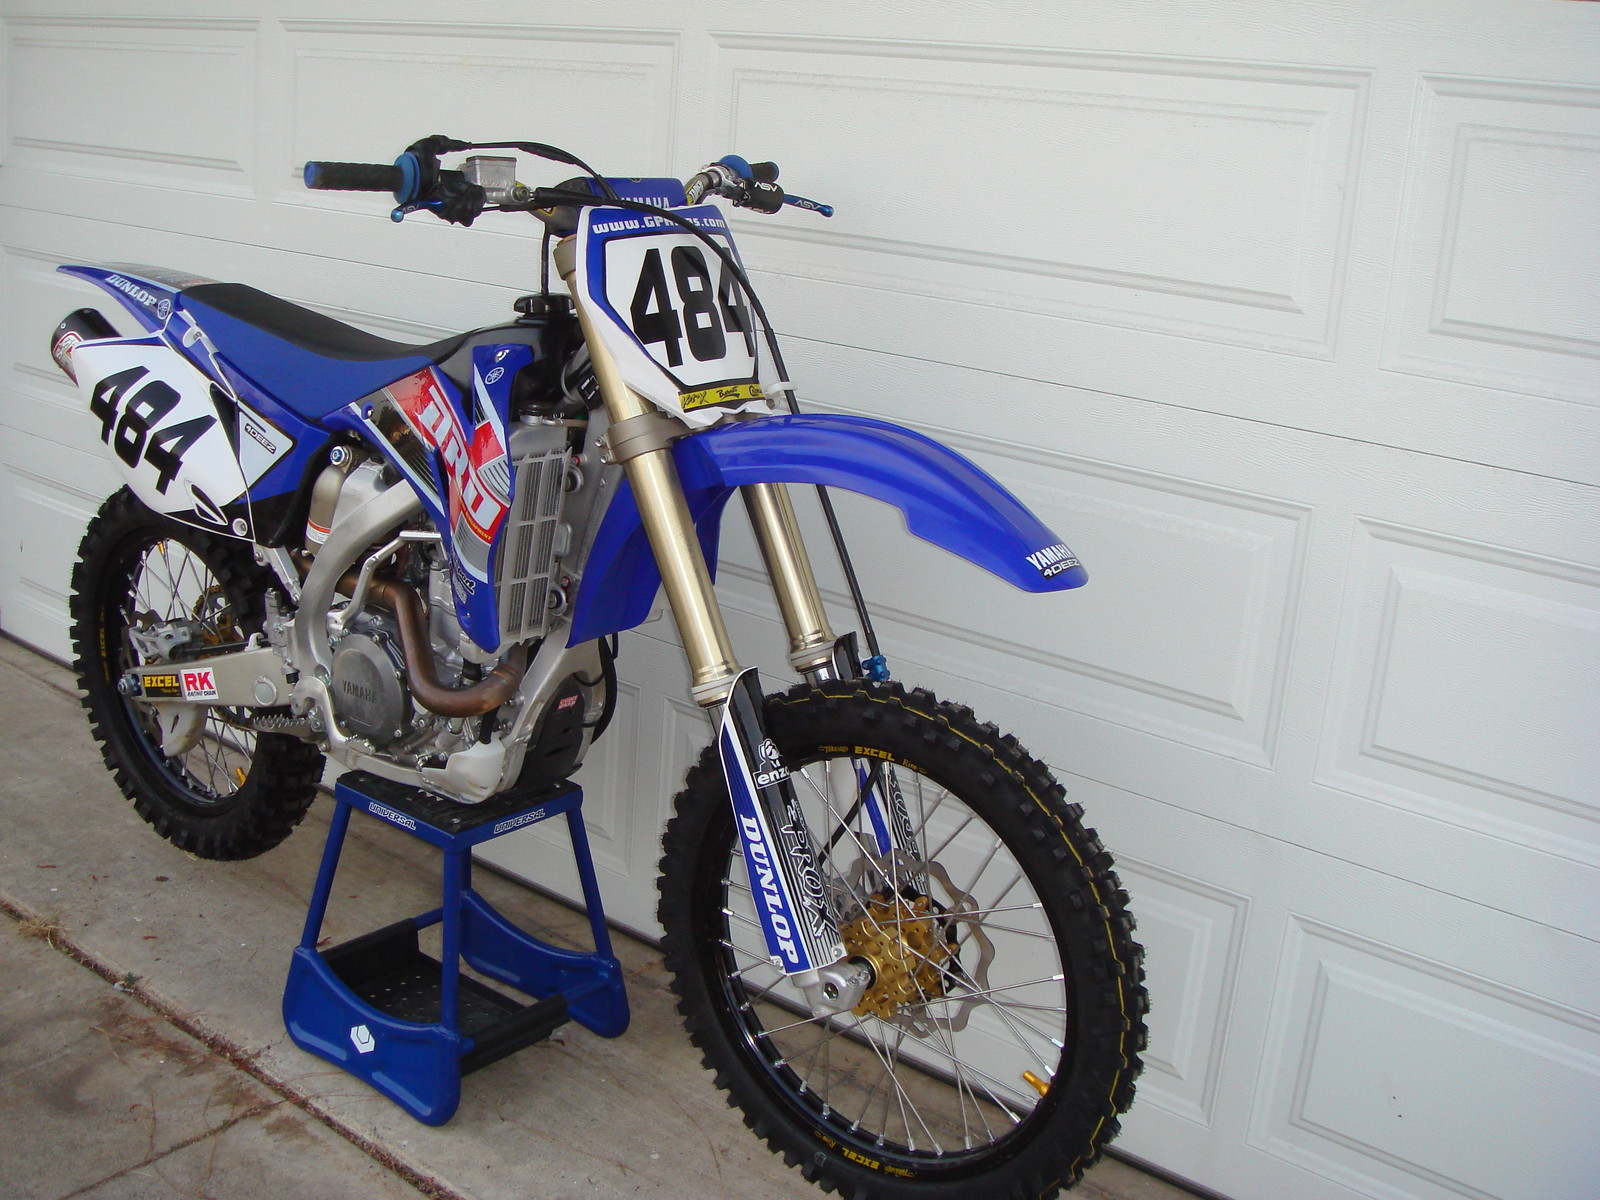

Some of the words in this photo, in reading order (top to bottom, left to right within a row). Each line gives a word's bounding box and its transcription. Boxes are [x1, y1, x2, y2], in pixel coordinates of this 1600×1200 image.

[755, 181, 778, 193] ASV
[794, 199, 820, 211] ASV
[105, 273, 158, 308] DUNLOP
[630, 246, 756, 369] 484
[90, 365, 218, 496] 484
[244, 423, 277, 455] 4DEEZ
[143, 675, 180, 688] EXCEL
[183, 671, 215, 691] RK
[342, 680, 378, 703] YAMAHA
[854, 745, 895, 762] EXCEL
[368, 802, 418, 831] UNIVERSAL
[493, 808, 547, 835] UNIVERSAL
[739, 813, 799, 964] DUNLOP
[841, 1146, 881, 1170] EXCEL
